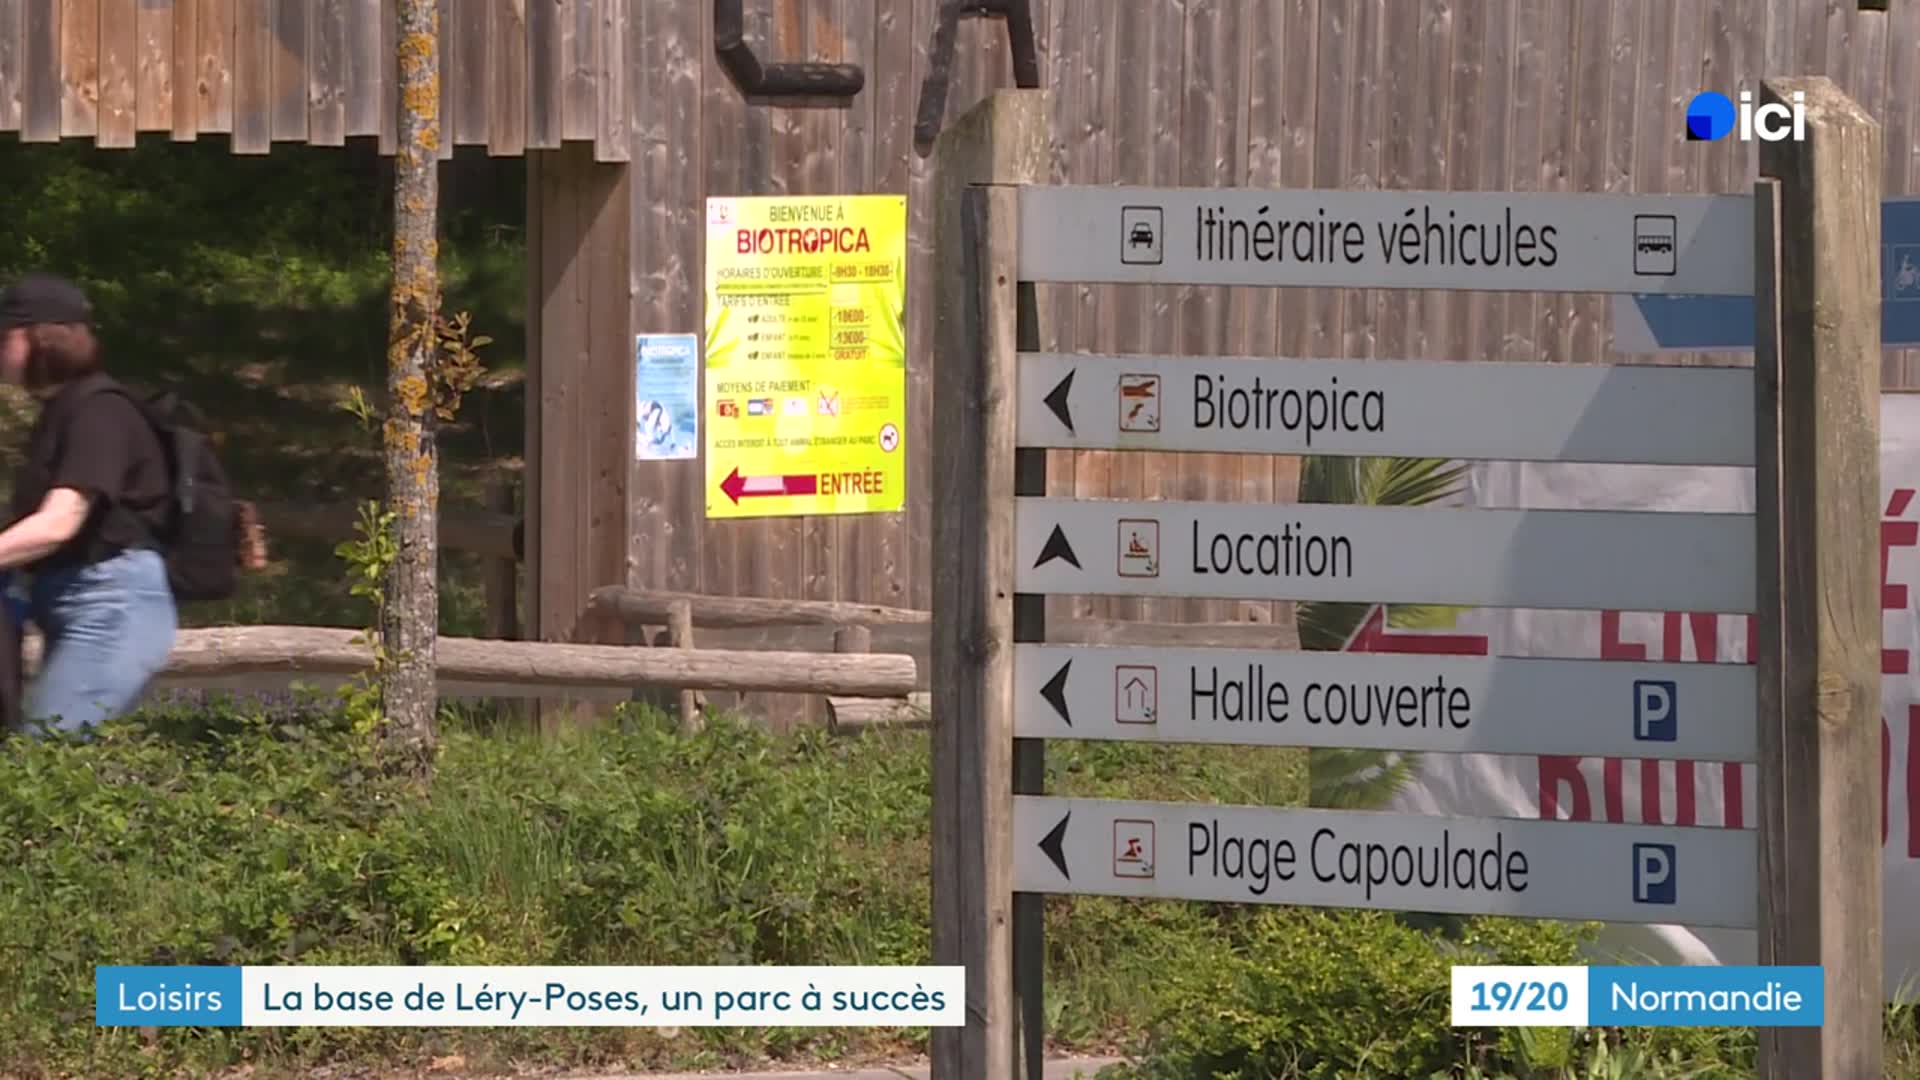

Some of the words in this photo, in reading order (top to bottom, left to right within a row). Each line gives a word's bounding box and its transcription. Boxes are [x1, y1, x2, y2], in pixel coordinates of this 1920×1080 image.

[769, 204, 834, 223] BIENVENUE
[836, 201, 845, 222] À
[737, 228, 871, 255] BIOTROPICA
[1196, 206, 1365, 264] Itinéraire
[1377, 205, 1559, 268] véhicules
[717, 267, 761, 280] HORAIRES
[763, 265, 824, 279] D'OUVERTURE
[717, 381, 753, 394] MOYENS
[755, 381, 767, 393] DE
[769, 380, 811, 393] PAIEMENT
[1192, 373, 1386, 446] Biotropica
[820, 467, 884, 495] ENTRÉE
[1192, 519, 1353, 578] Location
[1190, 663, 1290, 724] Halle
[1303, 675, 1472, 730] couverte
[1188, 822, 1297, 896] Plage
[1310, 828, 1530, 901] Capoulade
